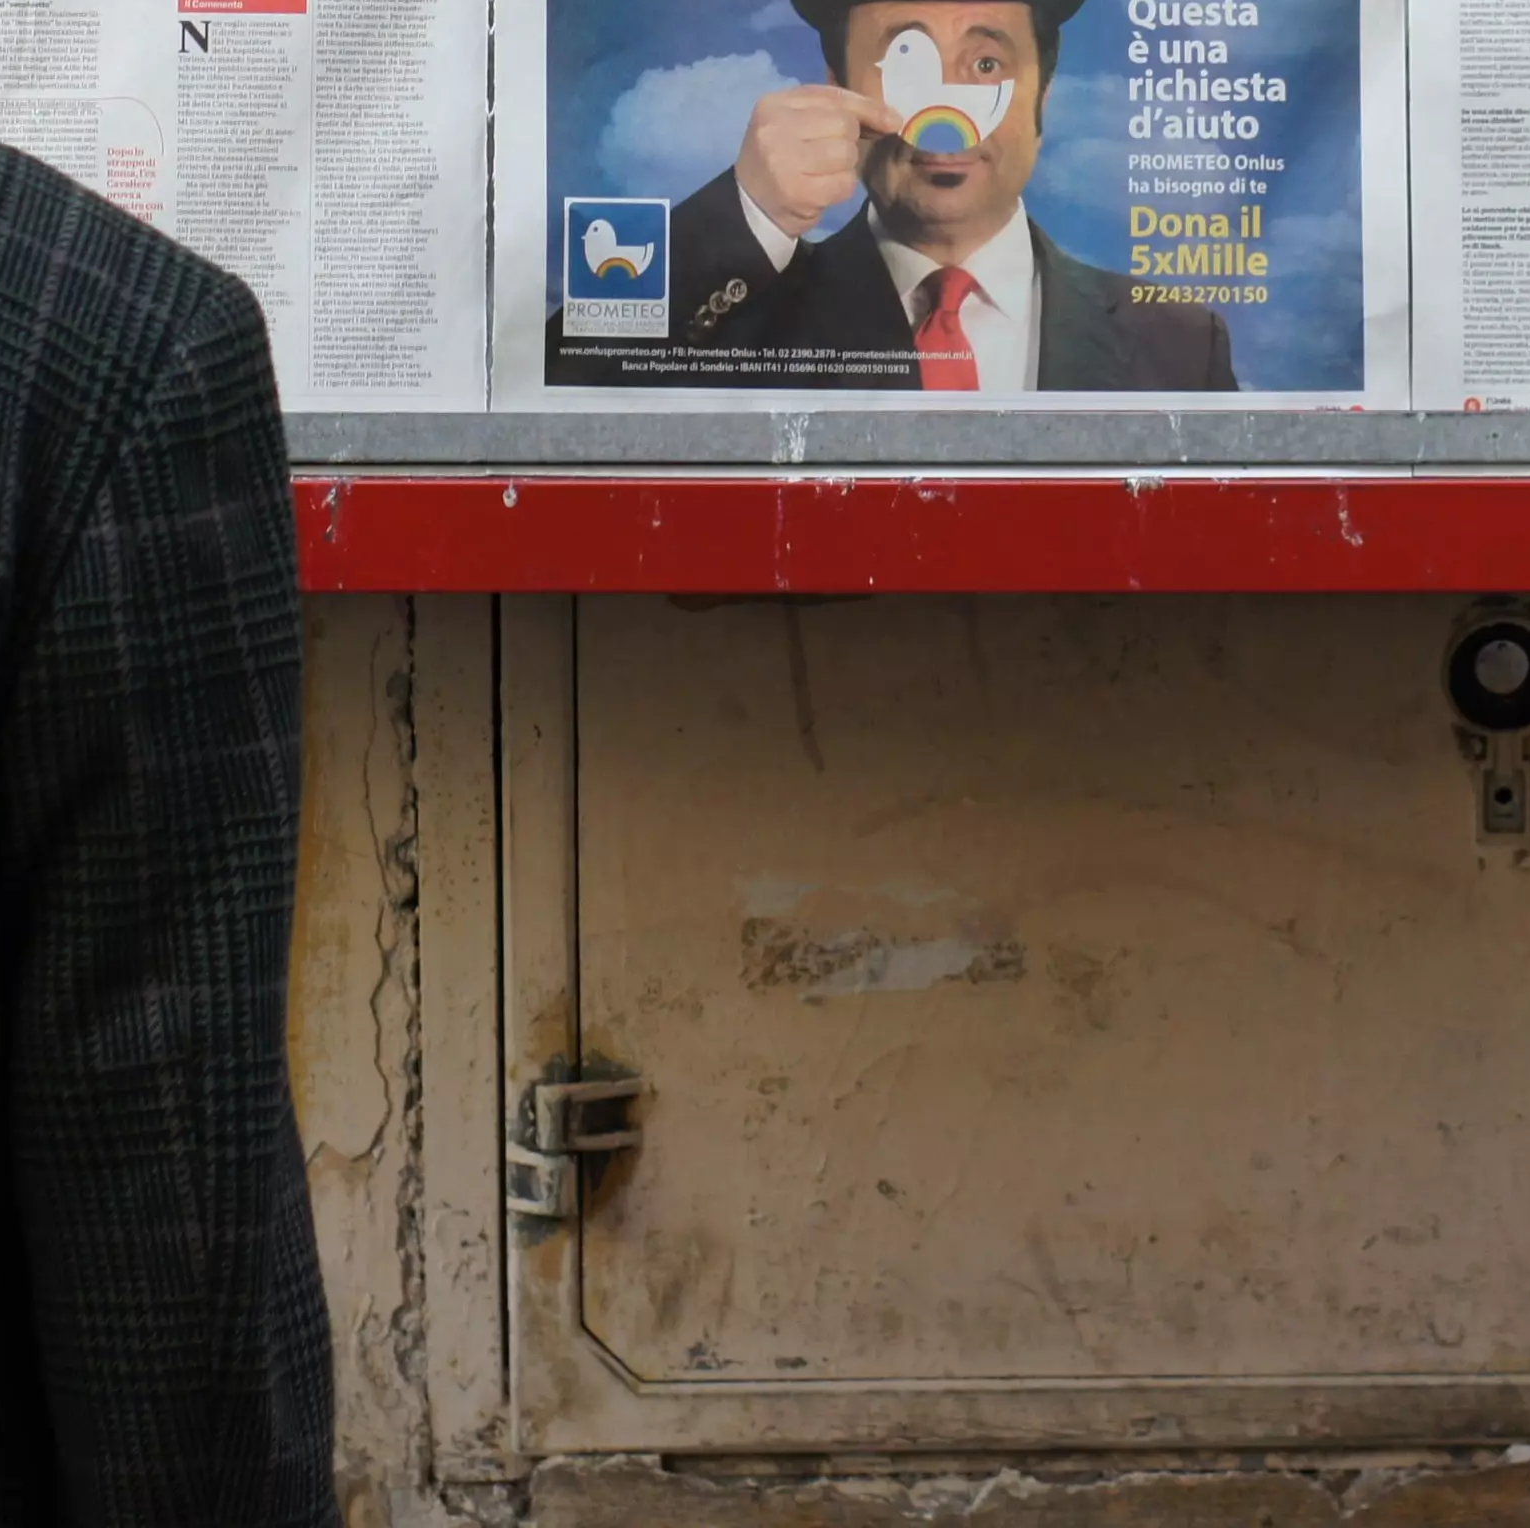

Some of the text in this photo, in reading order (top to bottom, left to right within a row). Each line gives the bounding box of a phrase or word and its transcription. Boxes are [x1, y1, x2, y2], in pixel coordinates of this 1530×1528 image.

[1128, 30, 1228, 64] è una
[1128, 68, 1286, 103] richiesta
[1128, 105, 1259, 141] d'aiuto
[1128, 153, 1285, 171] PROMETEO Onlus
[1128, 176, 1267, 198] ha bisogno di te
[1130, 205, 1261, 239] Dona il
[1130, 242, 1269, 277] 5xMille
[566, 301, 666, 319] PROMETEO
[1131, 285, 1268, 304] 97243270150
